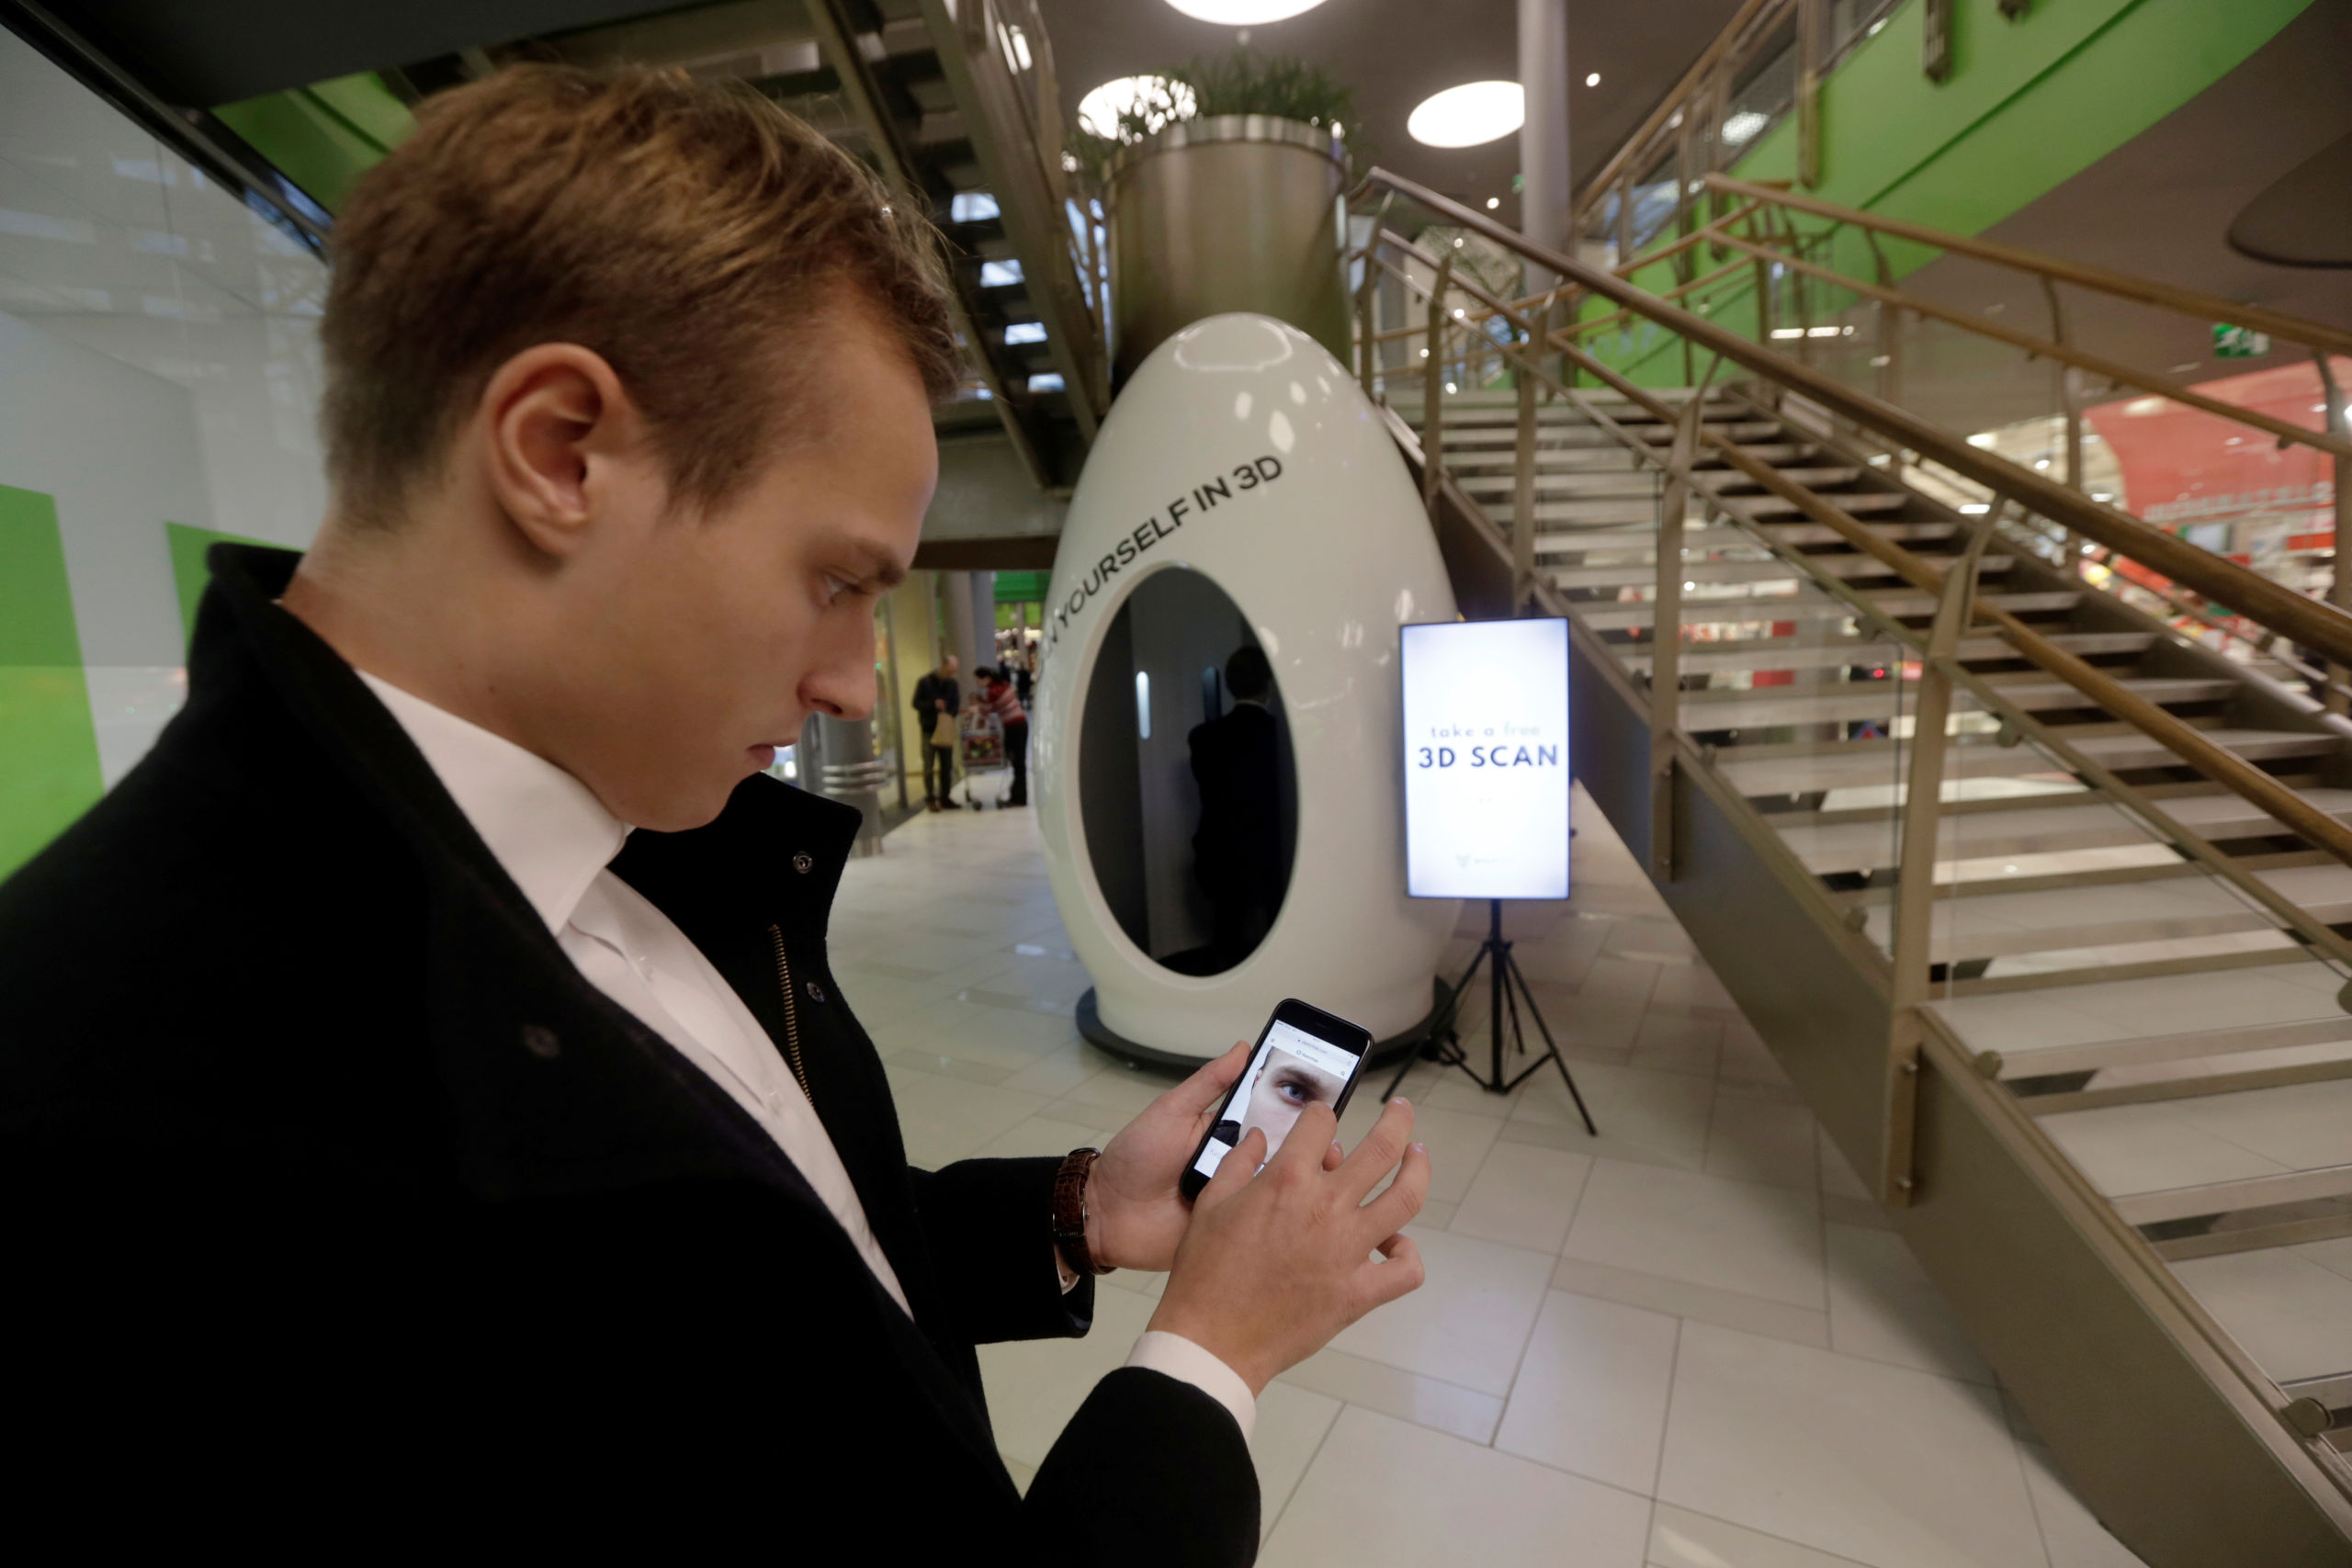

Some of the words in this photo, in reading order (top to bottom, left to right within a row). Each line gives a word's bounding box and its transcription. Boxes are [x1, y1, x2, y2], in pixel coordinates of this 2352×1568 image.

[1057, 497, 1190, 628] YOURSELF
[1193, 476, 1232, 513] IN
[1232, 455, 1283, 491] 3D
[1430, 723, 1475, 739] take
[1484, 727, 1495, 738] a
[1504, 722, 1540, 736] free
[1419, 747, 1456, 768] 3D
[1471, 745, 1558, 767] SCAN
